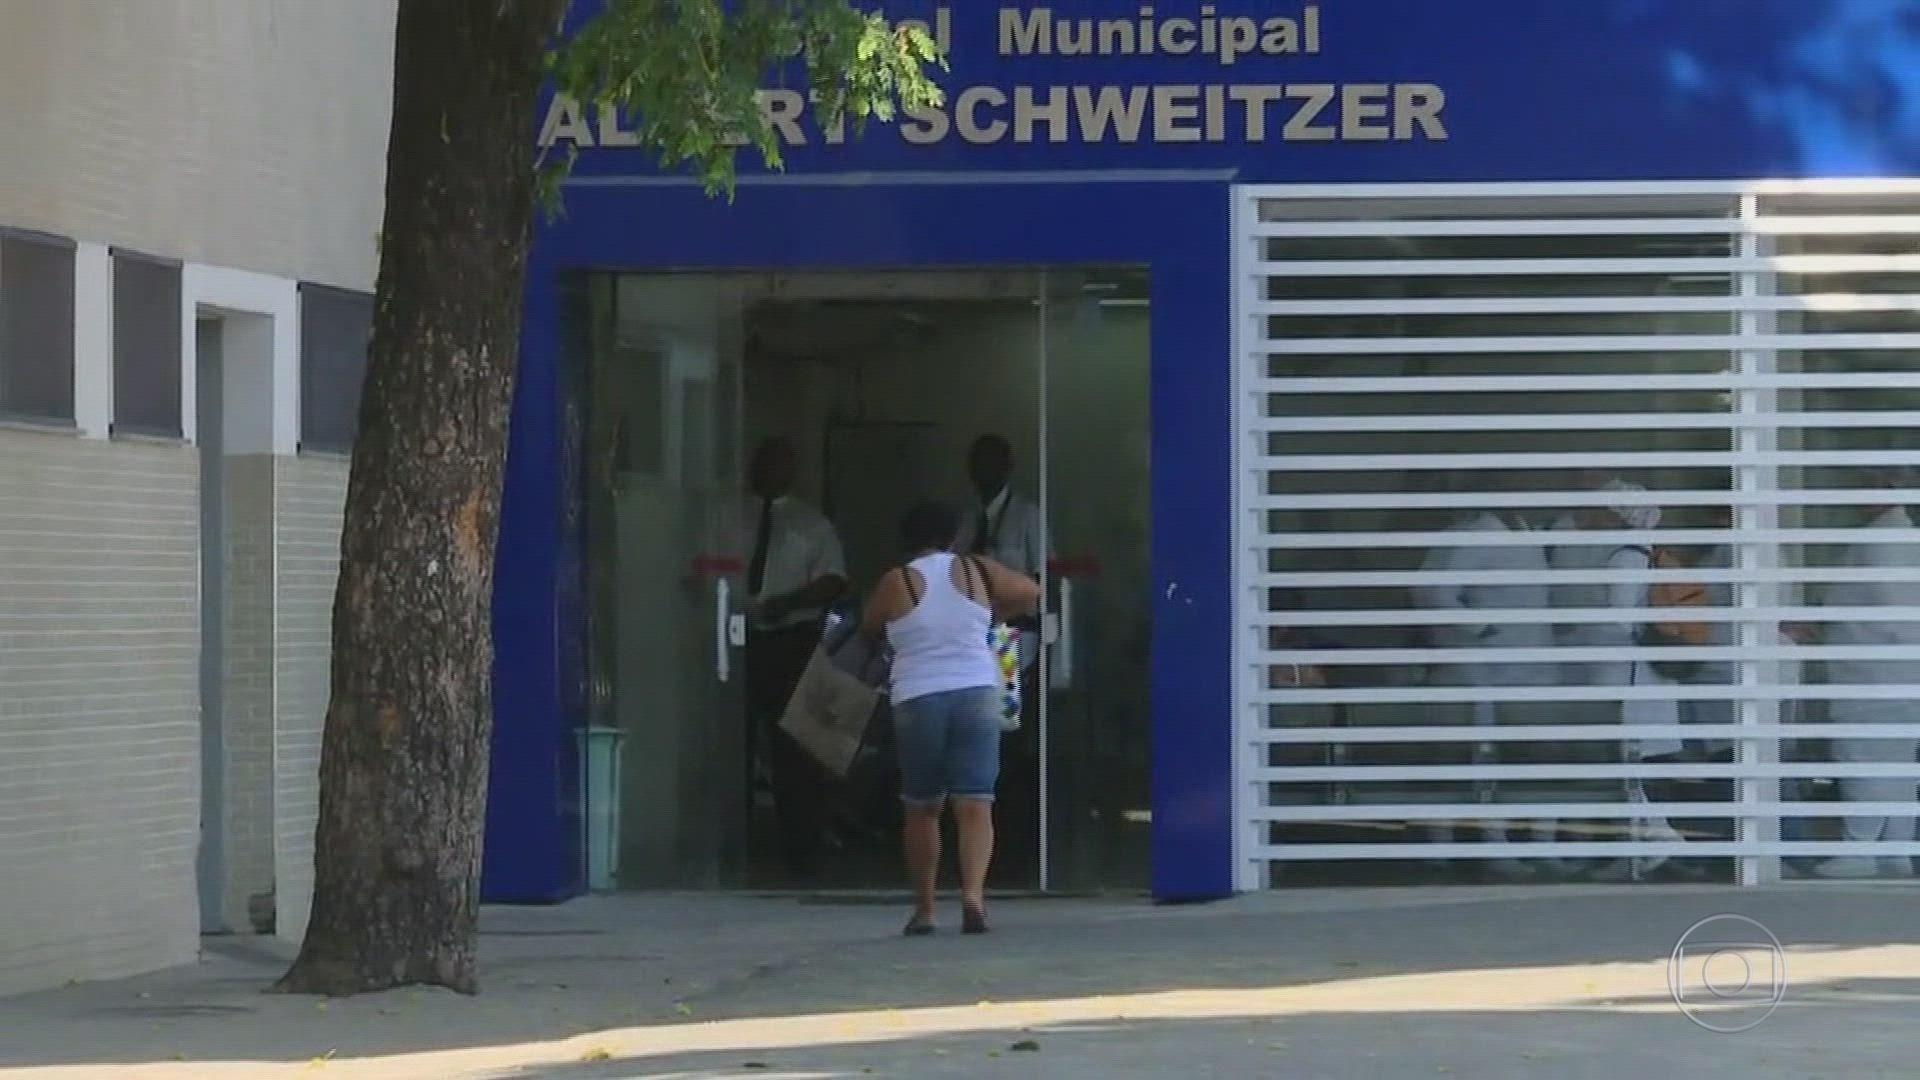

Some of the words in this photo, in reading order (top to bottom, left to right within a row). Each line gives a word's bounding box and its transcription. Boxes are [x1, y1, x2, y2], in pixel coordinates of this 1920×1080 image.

[998, 5, 1321, 64] Municipal
[537, 90, 862, 147] ALRT
[898, 83, 1449, 143] SCHWEITZER
